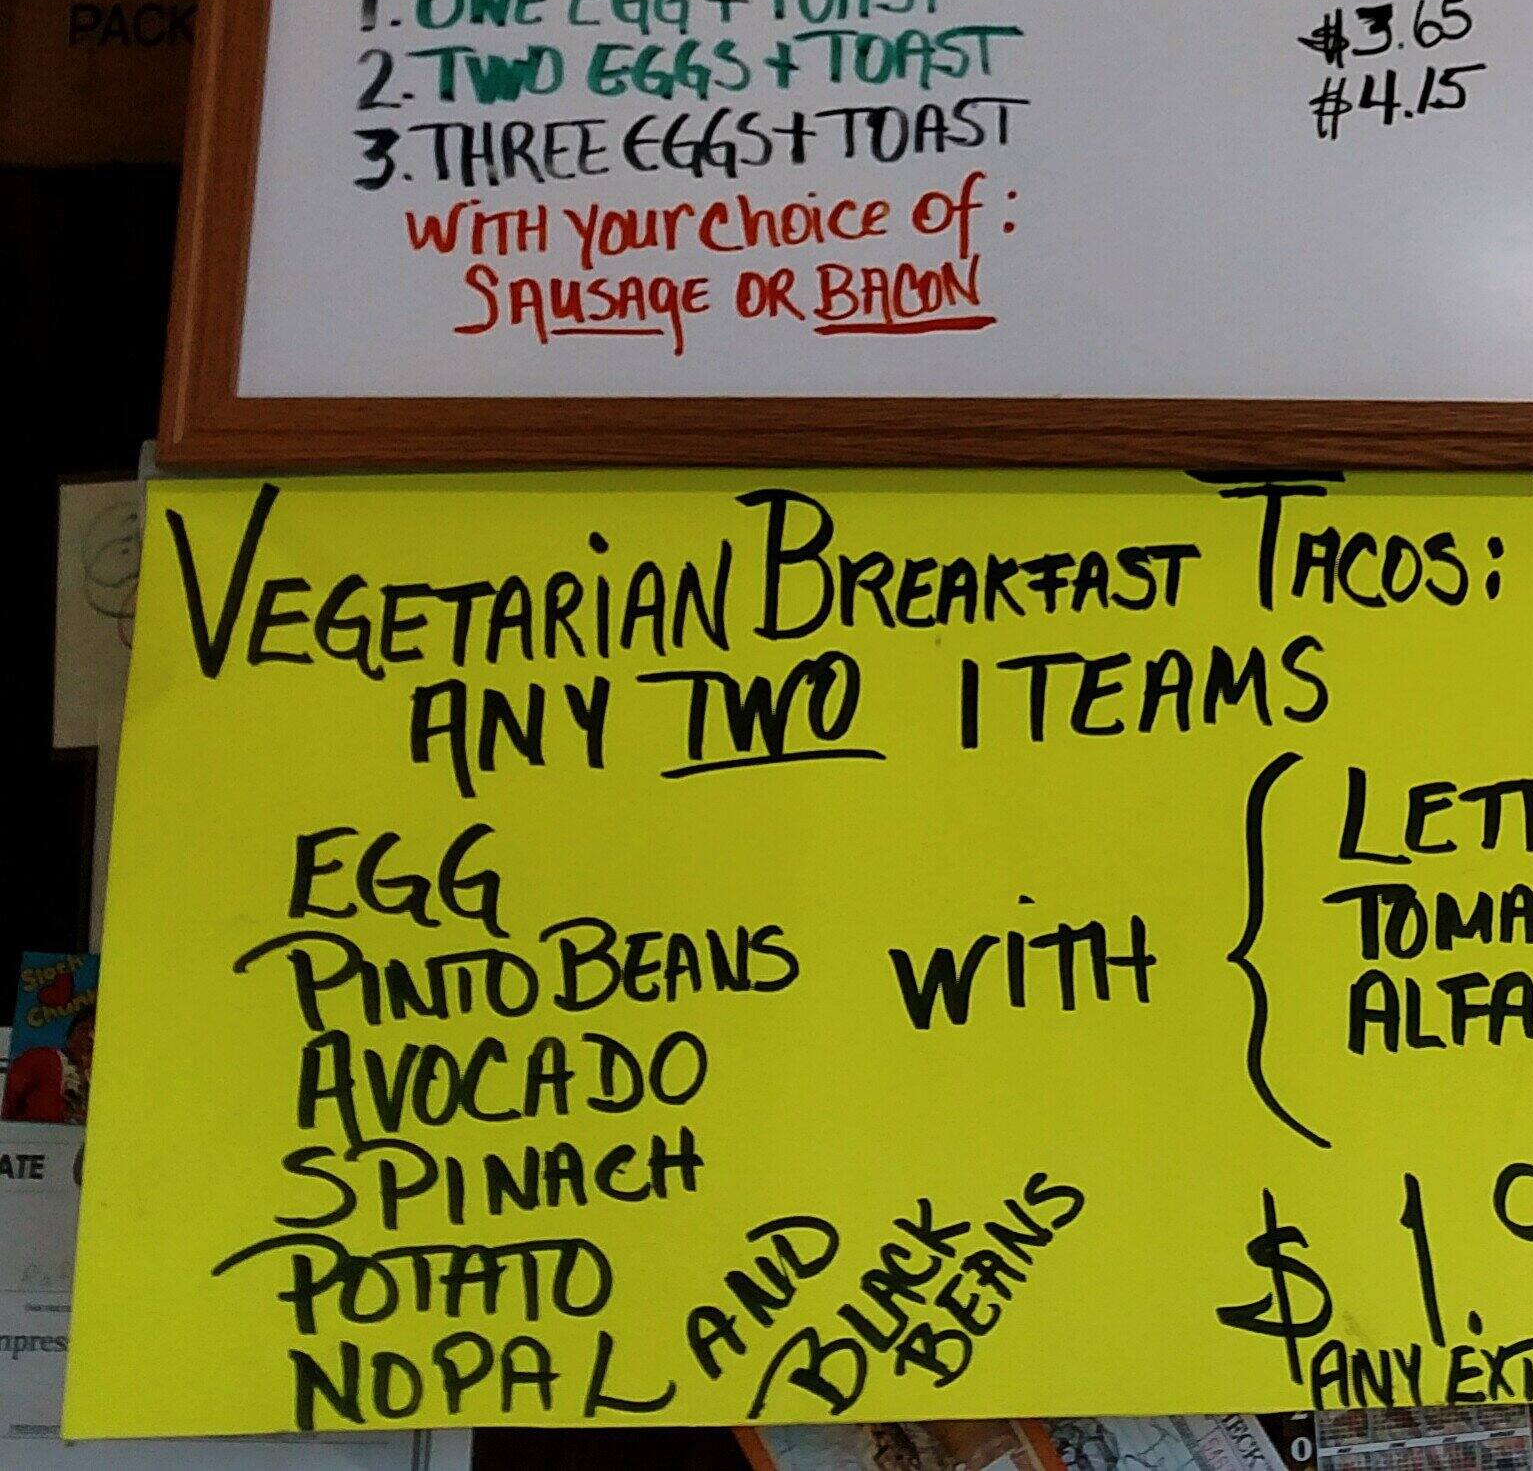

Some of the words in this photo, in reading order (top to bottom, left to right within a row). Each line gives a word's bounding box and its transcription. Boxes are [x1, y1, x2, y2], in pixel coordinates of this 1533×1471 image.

[408, 42, 564, 105] TWO
[588, 38, 751, 101] EGGS
[793, 25, 1024, 89] TOAST
[408, 117, 610, 187] THREE
[624, 109, 775, 180] EGGS
[815, 98, 1030, 162] TOAST
[454, 264, 710, 356] SAUSAGE
[736, 270, 807, 322] OR
[814, 253, 980, 321] BACON
[166, 483, 730, 679] VEGETARIAN
[737, 488, 1199, 640] BREAKFAST
[410, 675, 610, 798] ANY
[638, 650, 862, 759] TWO
[962, 635, 1329, 749] ITEAMS
[287, 823, 509, 937] EGG
[234, 930, 538, 1030] PINTO
[540, 916, 800, 1011] BEANS
[297, 1028, 708, 1140] AVOCADO
[274, 1126, 705, 1230] SPINACH
[213, 1234, 613, 1334] POTATO
[687, 1215, 840, 1380] AND
[747, 1196, 972, 1420] BLACK
[894, 1172, 1085, 1388] BEANS
[289, 1331, 676, 1431] NOPAL
[1310, 1339, 1422, 1408] ANY
